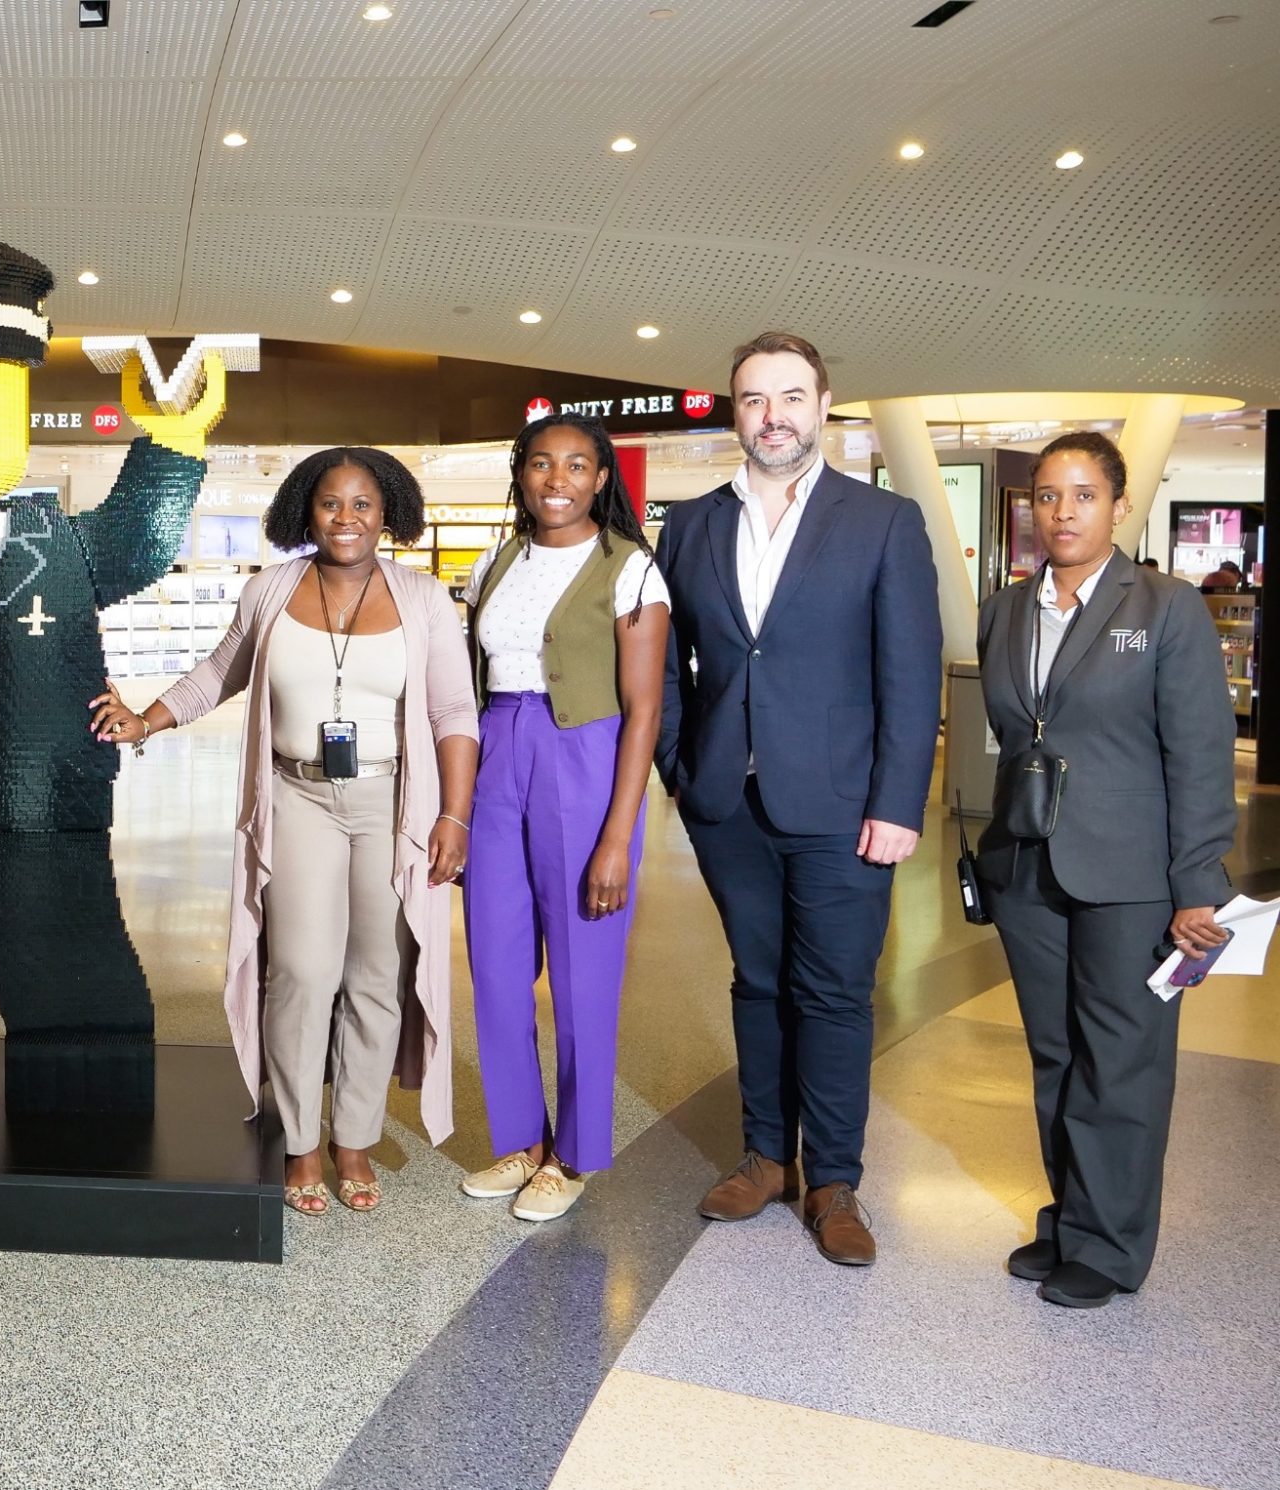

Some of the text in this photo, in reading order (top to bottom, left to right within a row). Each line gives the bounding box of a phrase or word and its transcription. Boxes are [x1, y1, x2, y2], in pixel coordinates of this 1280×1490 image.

[621, 395, 674, 415] FREE
[685, 393, 711, 409] DFS
[30, 413, 82, 428] FREE
[95, 415, 118, 427] DFS
[1110, 629, 1148, 653] T4
